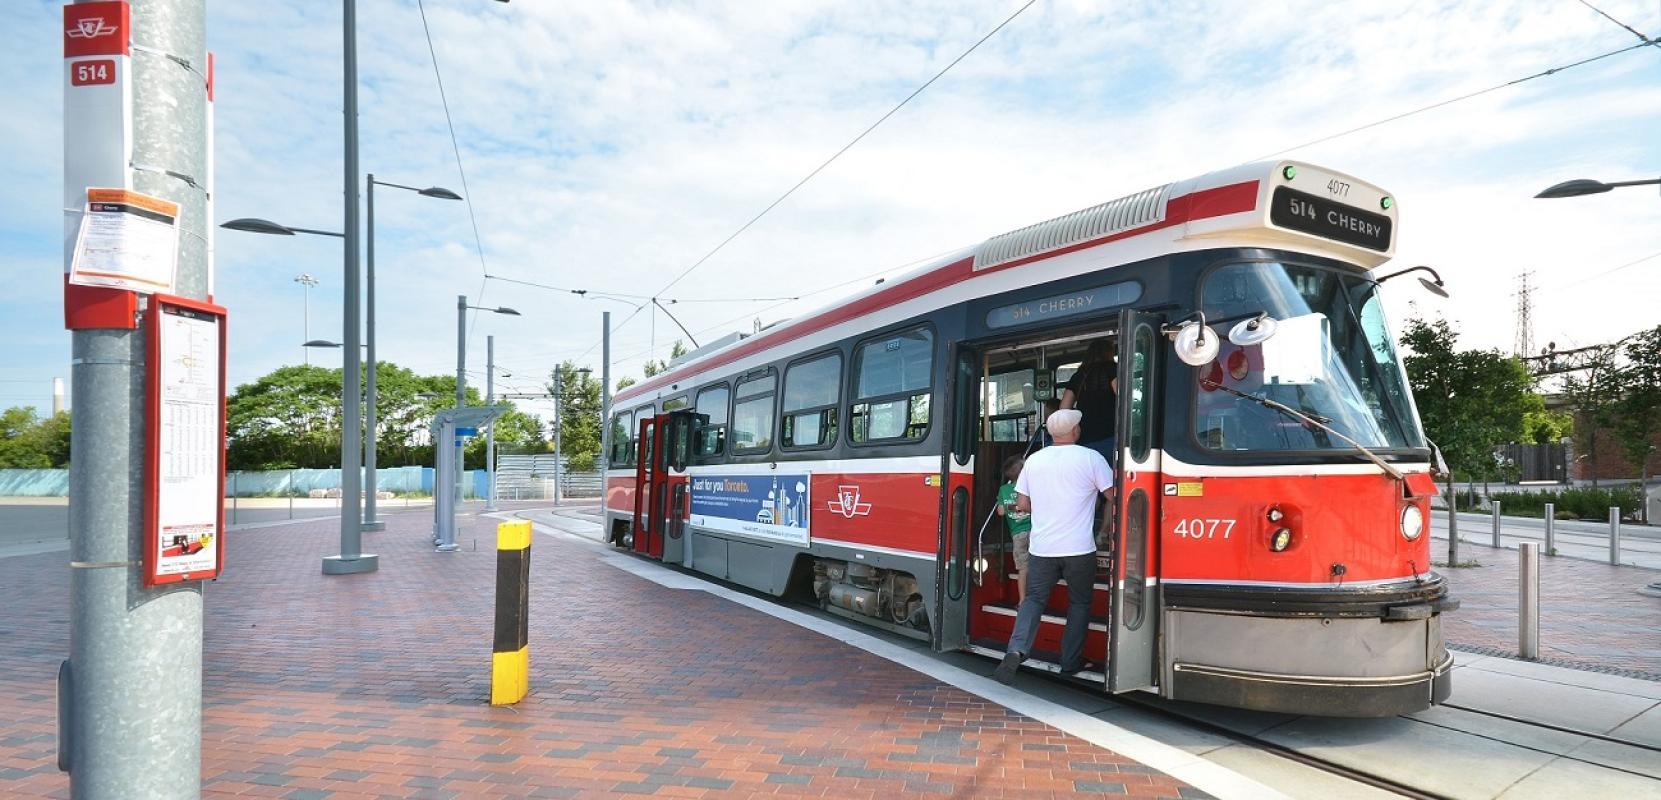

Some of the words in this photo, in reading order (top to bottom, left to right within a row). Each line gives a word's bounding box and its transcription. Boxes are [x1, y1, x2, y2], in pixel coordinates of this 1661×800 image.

[79, 65, 107, 81] 514
[1327, 179, 1350, 197] 4077
[1290, 199, 1317, 220] 514
[1327, 211, 1381, 238] CHERRY
[1012, 305, 1031, 320] 514
[1039, 294, 1095, 314] CHERRY
[693, 479, 704, 490] Just
[712, 481, 724, 494] you
[1173, 518, 1236, 539] 4077
